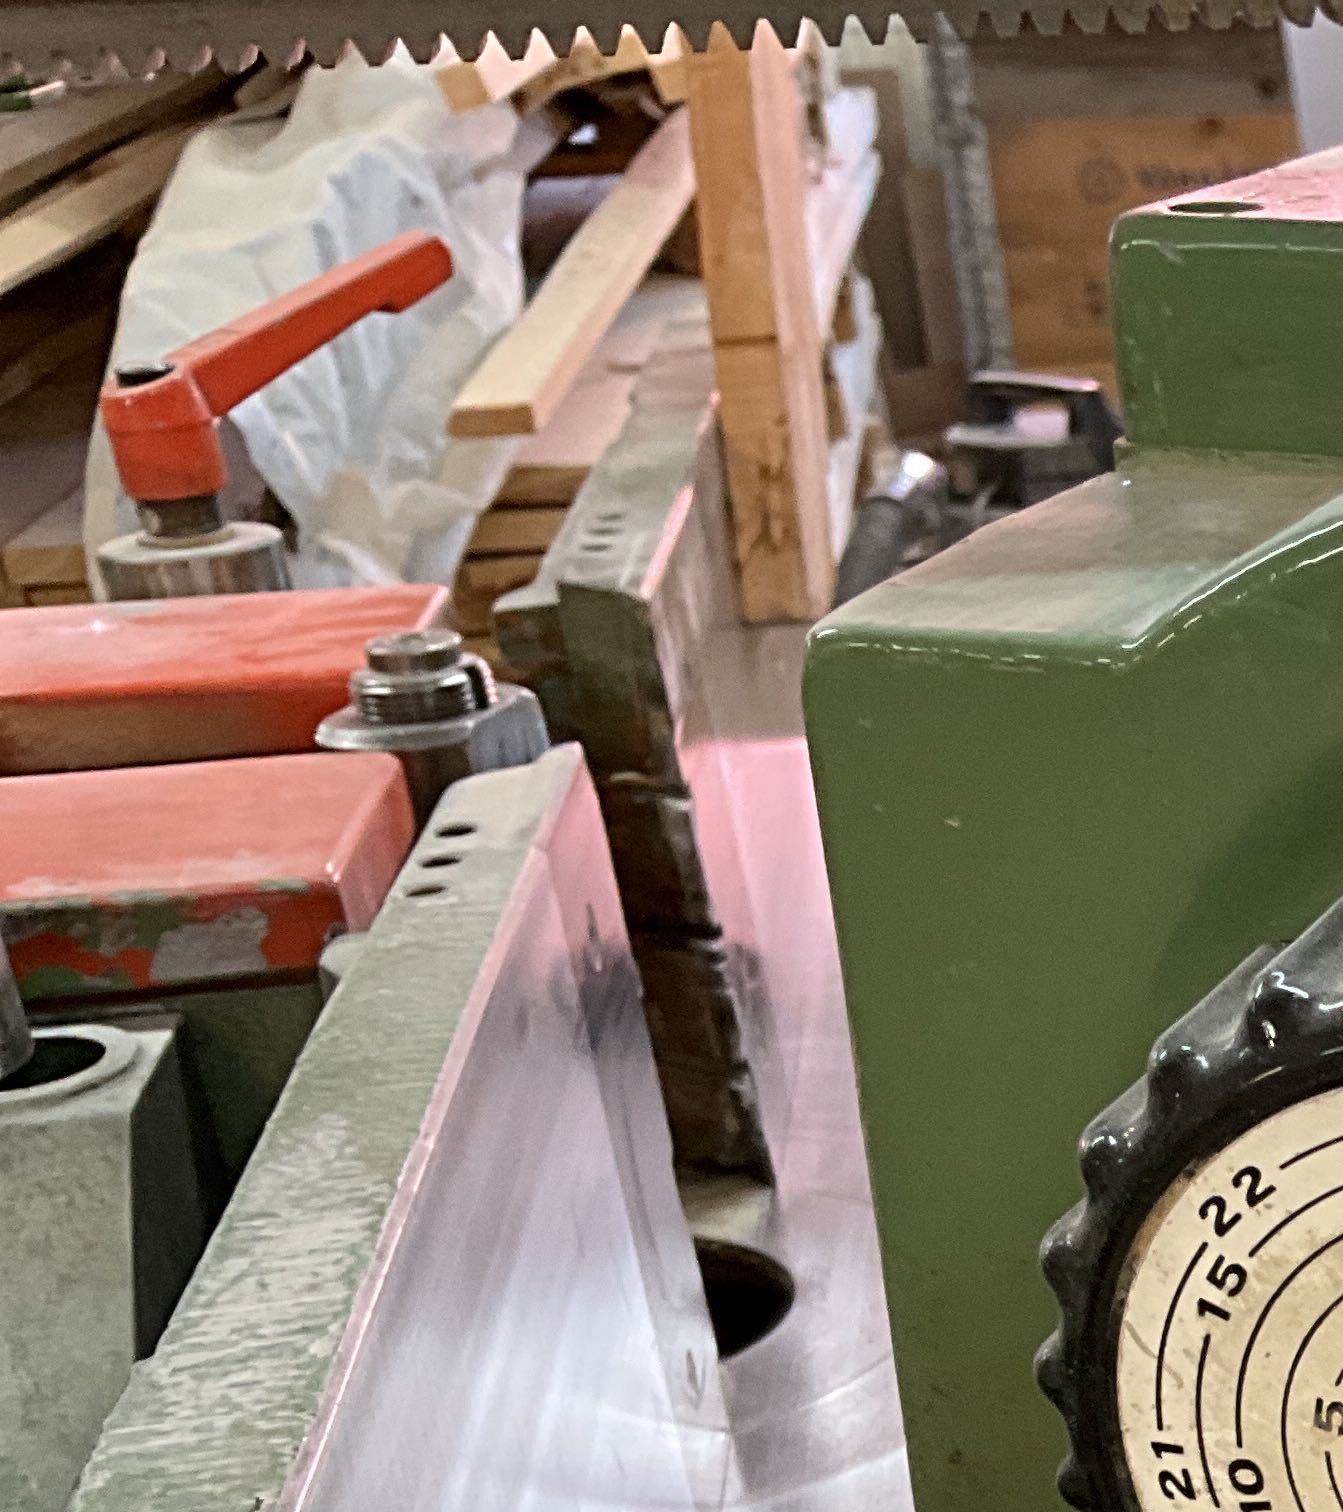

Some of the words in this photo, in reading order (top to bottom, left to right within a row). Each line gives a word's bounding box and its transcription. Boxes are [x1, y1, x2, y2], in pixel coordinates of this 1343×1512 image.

[1198, 1165, 1277, 1238] 22
[1196, 1253, 1249, 1323] 15
[1149, 1439, 1199, 1503] 21
